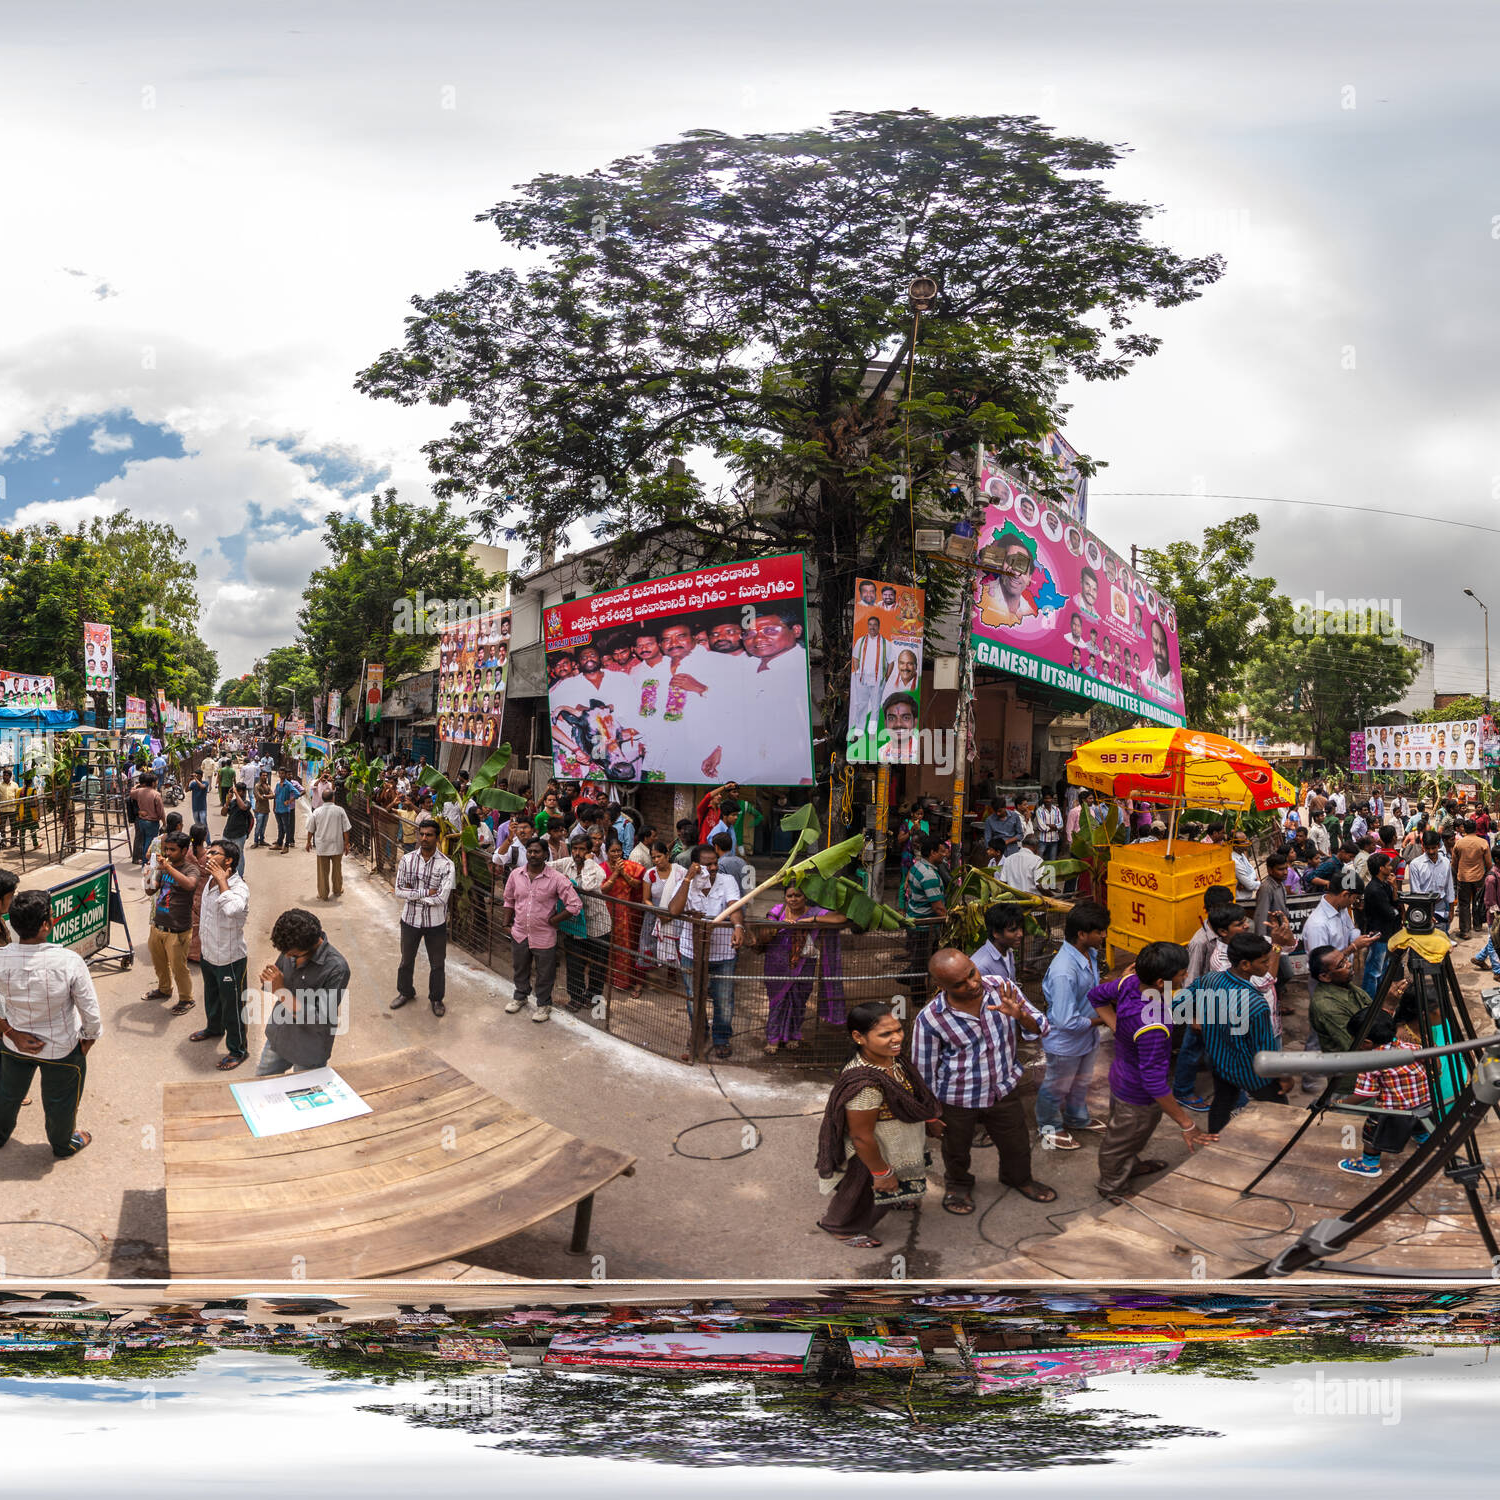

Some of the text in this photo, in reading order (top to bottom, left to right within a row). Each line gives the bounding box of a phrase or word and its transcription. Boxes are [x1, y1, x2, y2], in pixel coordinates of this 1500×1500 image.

[547, 634, 590, 650] M.RAJU YADAV
[977, 642, 1038, 679] GANESH
[1041, 662, 1082, 694] UTSAV
[1084, 678, 1138, 714] COMMITTEE
[1100, 754, 1154, 764] 98.3 FM
[54, 894, 74, 917] THE
[52, 904, 104, 942] NOISE DOWN
